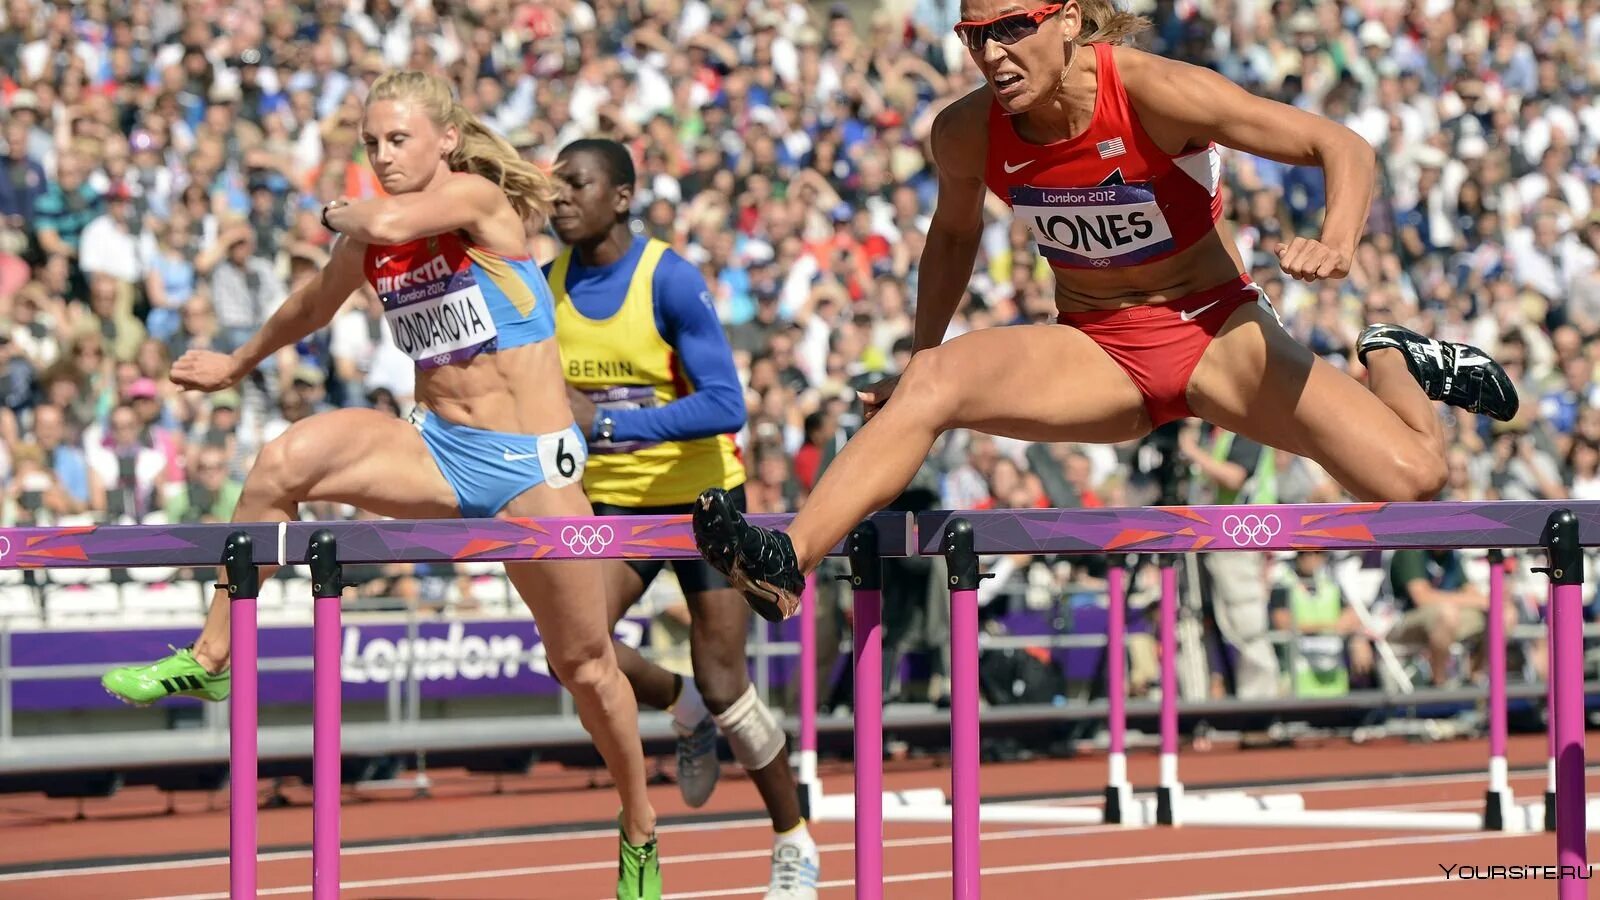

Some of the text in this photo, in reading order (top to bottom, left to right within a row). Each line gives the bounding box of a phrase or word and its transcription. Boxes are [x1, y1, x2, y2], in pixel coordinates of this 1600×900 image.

[1042, 190, 1116, 203] London 2012
[1034, 211, 1153, 251] JONES
[396, 282, 446, 304] London 2012
[568, 360, 634, 377] BENIN
[556, 438, 575, 478] 6
[340, 622, 523, 683] London
